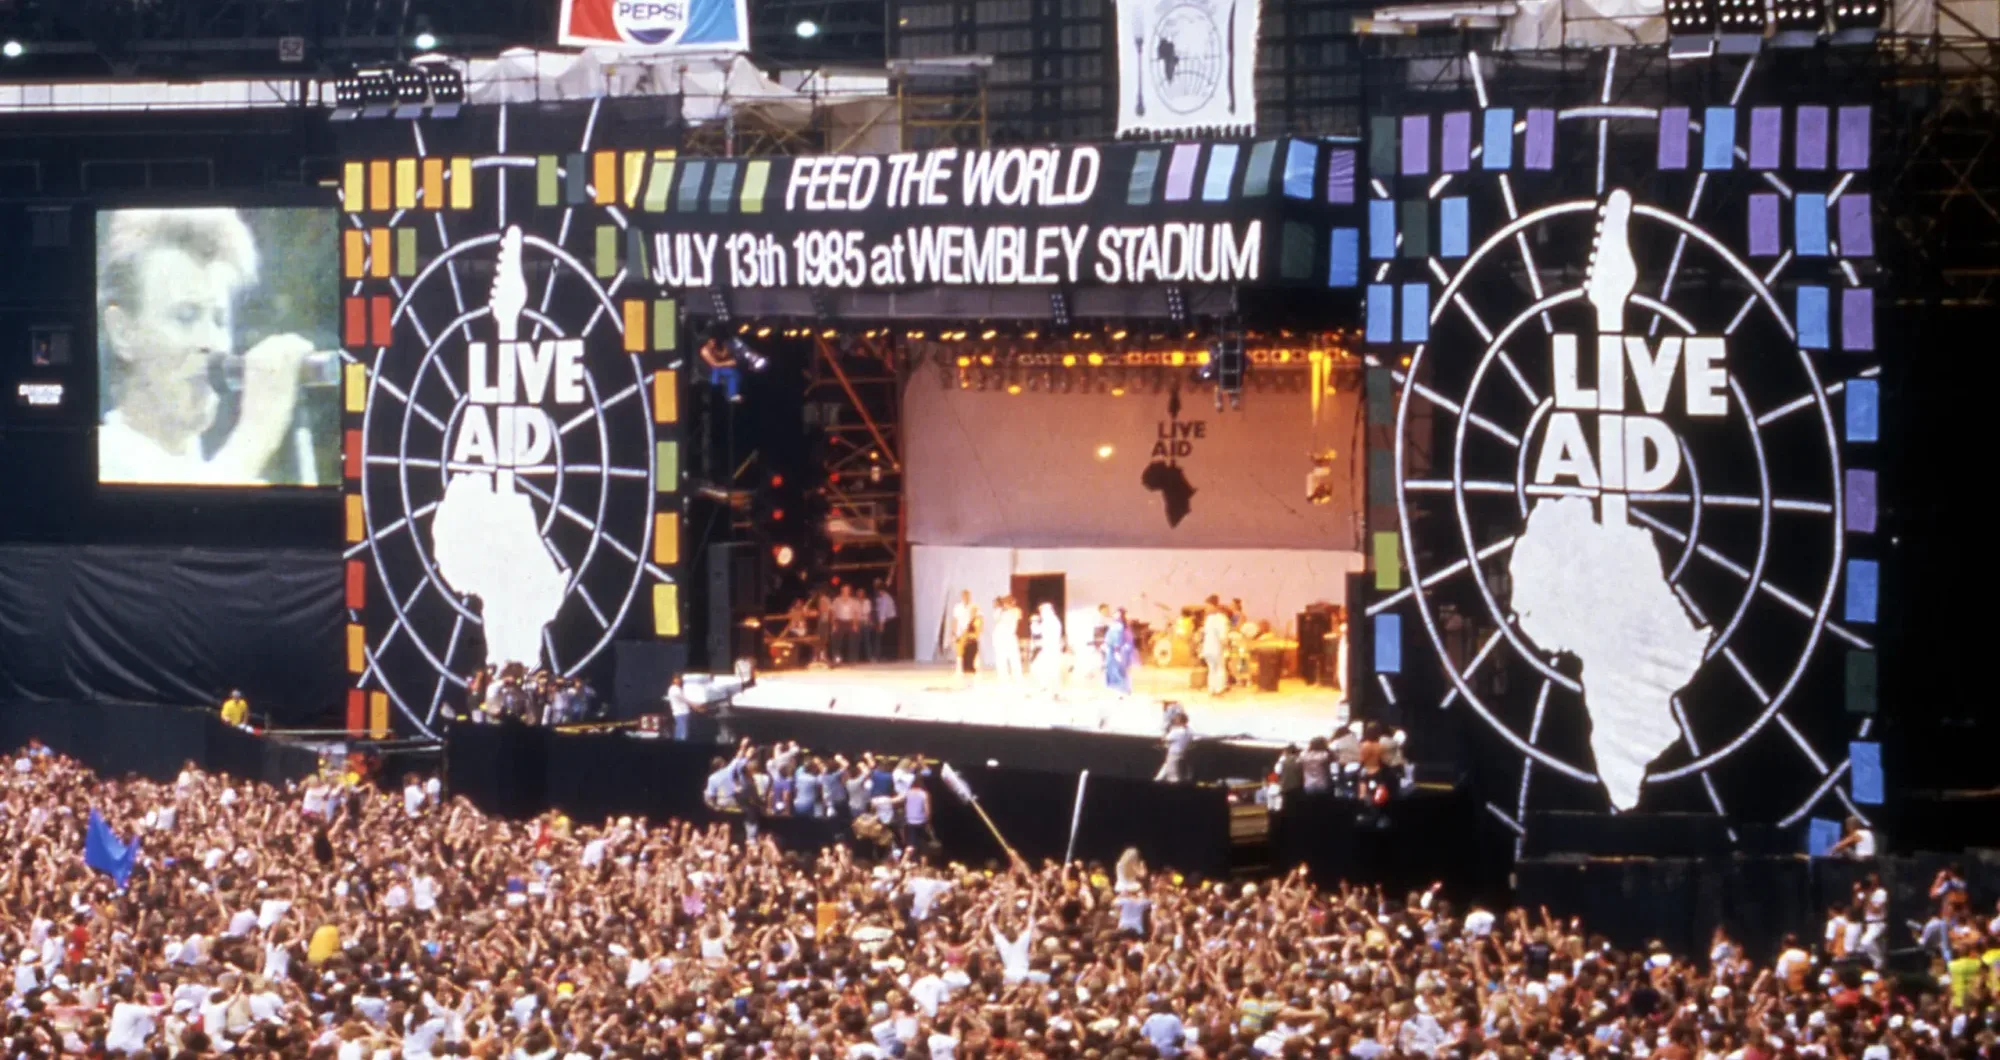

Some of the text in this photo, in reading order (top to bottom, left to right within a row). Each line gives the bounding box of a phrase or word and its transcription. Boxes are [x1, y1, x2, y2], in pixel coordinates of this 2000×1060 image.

[618, 2, 684, 21] PEPSI
[785, 146, 1100, 212] FEED THE WORLD
[652, 219, 1262, 288] JULY 13th 1985 at WEMBLEY STADIUM
[468, 338, 585, 404] LIVE
[1552, 333, 1728, 415] LIVE
[452, 404, 552, 466] AID
[1151, 440, 1193, 458] AID
[1157, 420, 1207, 439] LIVE
[1534, 412, 1681, 492] AID
